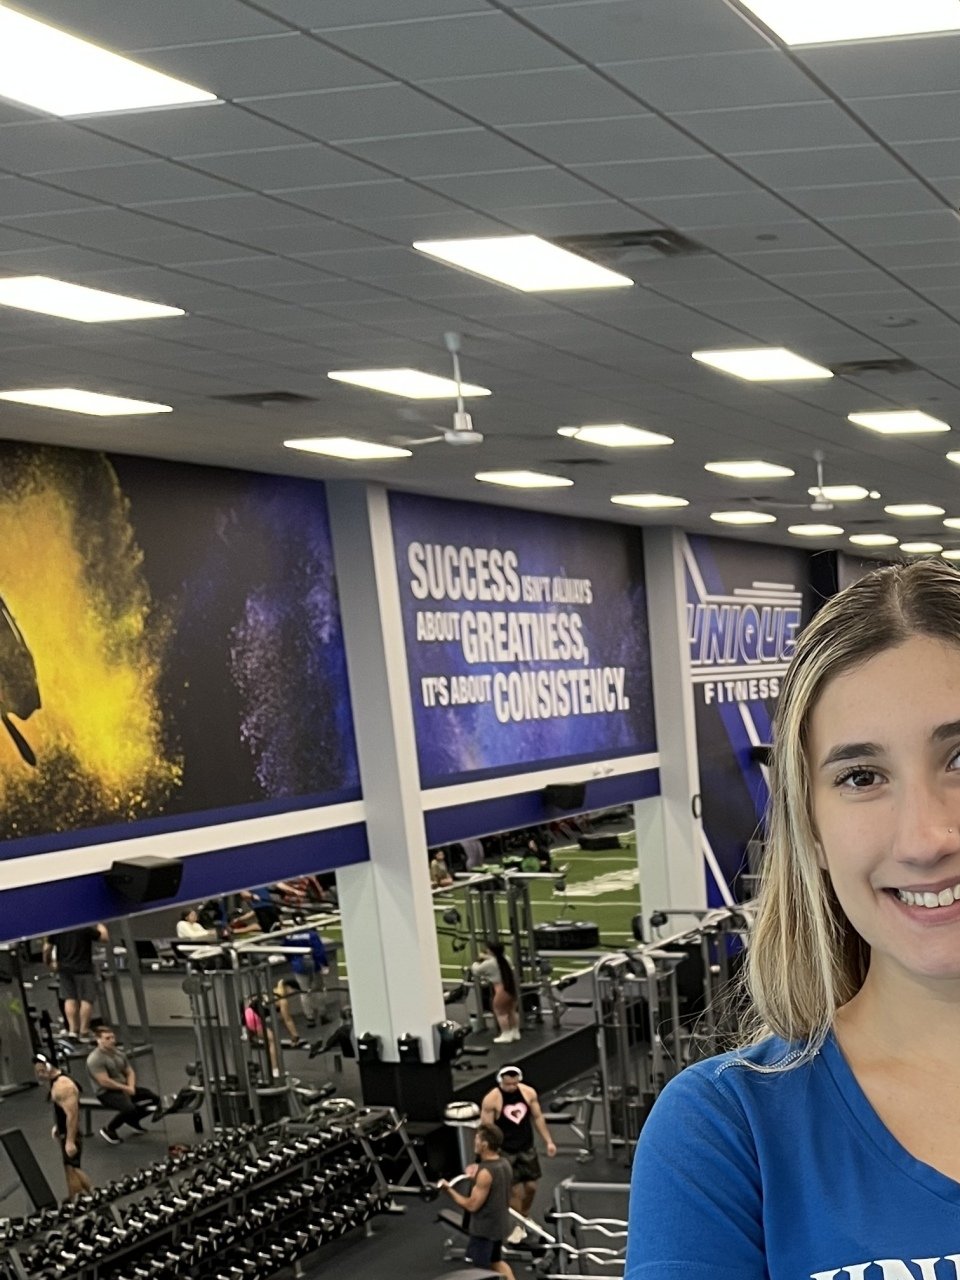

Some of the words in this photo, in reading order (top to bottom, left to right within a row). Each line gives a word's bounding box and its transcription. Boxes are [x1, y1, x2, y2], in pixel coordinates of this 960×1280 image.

[408, 541, 521, 602] SUCCESS
[521, 575, 551, 603] ISN'T
[416, 611, 461, 641] ABOUT
[460, 610, 589, 666] GREATNESS,
[686, 604, 801, 664] UNIQUE
[421, 676, 450, 707] IT'S
[450, 674, 492, 704] ABOUT
[493, 667, 630, 723] CONSISTENCY.
[704, 678, 780, 705] FITNESS
